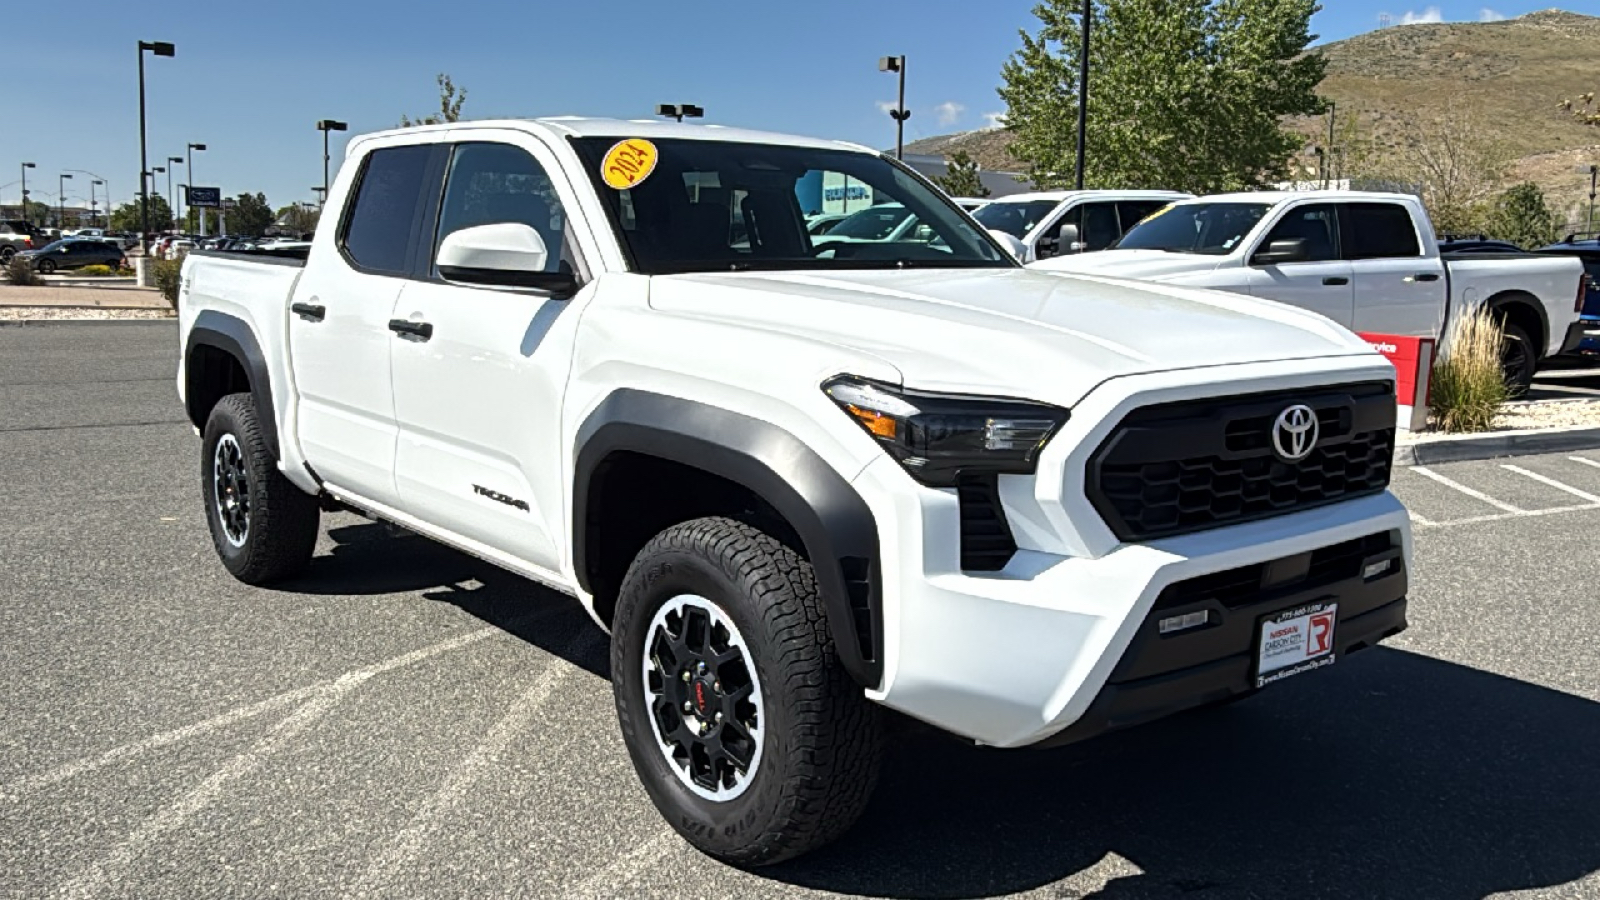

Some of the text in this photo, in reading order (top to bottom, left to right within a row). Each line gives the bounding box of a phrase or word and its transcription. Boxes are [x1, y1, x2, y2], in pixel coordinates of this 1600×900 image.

[609, 143, 648, 183] 2024
[471, 483, 530, 513] TACOMA
[1270, 626, 1299, 639] NISSAN
[1265, 637, 1290, 651] CARSON
